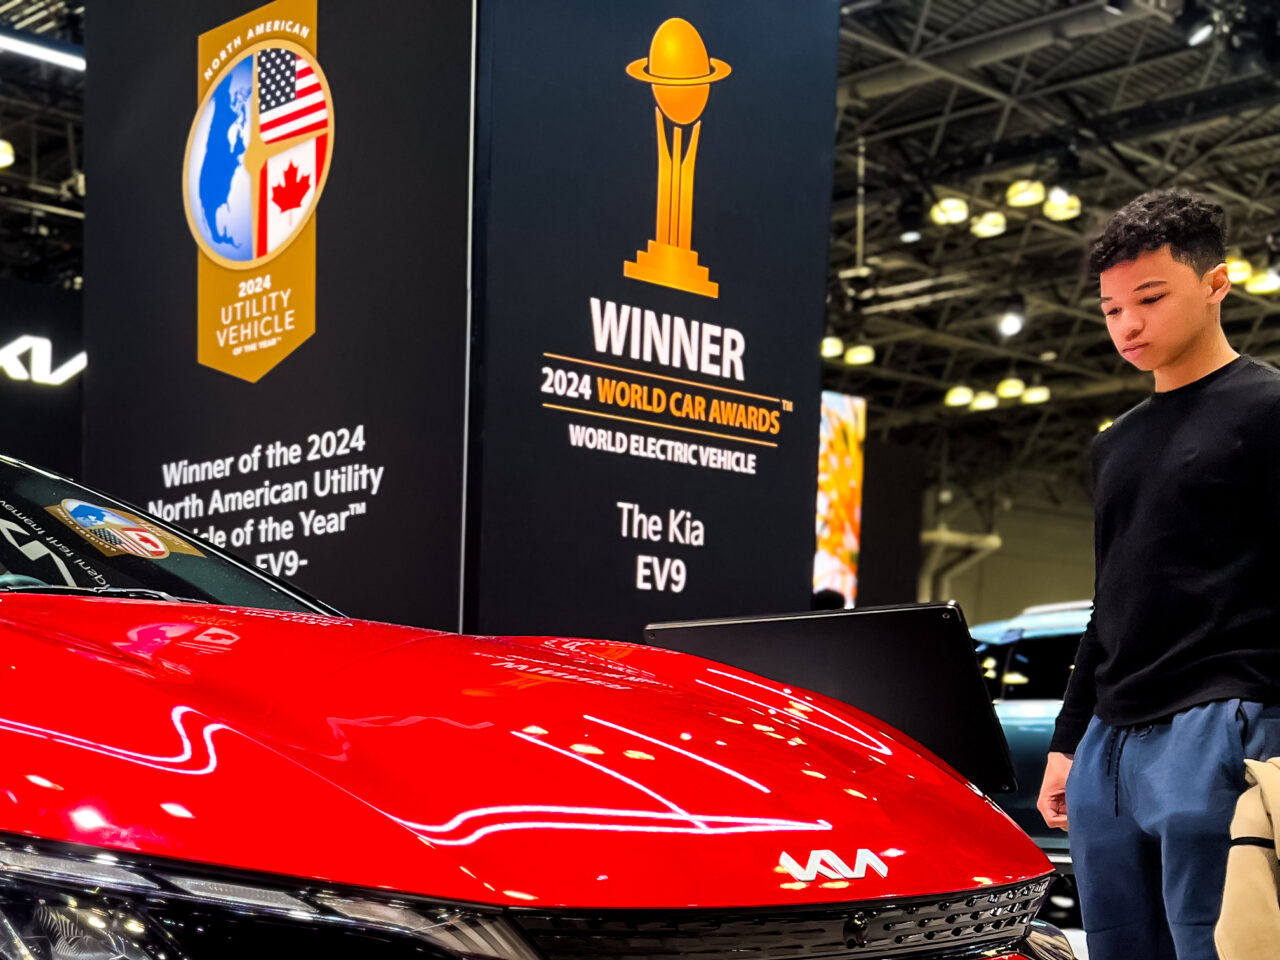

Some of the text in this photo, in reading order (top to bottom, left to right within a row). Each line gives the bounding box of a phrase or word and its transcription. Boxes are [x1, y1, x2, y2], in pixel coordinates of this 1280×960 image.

[203, 19, 310, 81] NORTH AMERICAN
[221, 288, 292, 325] UTILITY
[238, 274, 271, 297] 2024
[216, 310, 296, 348] VEHICLE
[232, 346, 243, 356] OF
[243, 342, 258, 353] THE
[590, 297, 745, 381] WINNER
[541, 367, 592, 400] 2024
[597, 377, 666, 414] WORLD
[669, 392, 706, 421] CAR
[162, 424, 366, 488] Winner of the 2024
[569, 424, 757, 475] WORLD ELECTRIC VEHICLE
[147, 464, 385, 523] North American Utility
[231, 518, 255, 548] of
[258, 516, 294, 543] the
[617, 501, 705, 547] The Kia
[636, 554, 687, 593] EV9
